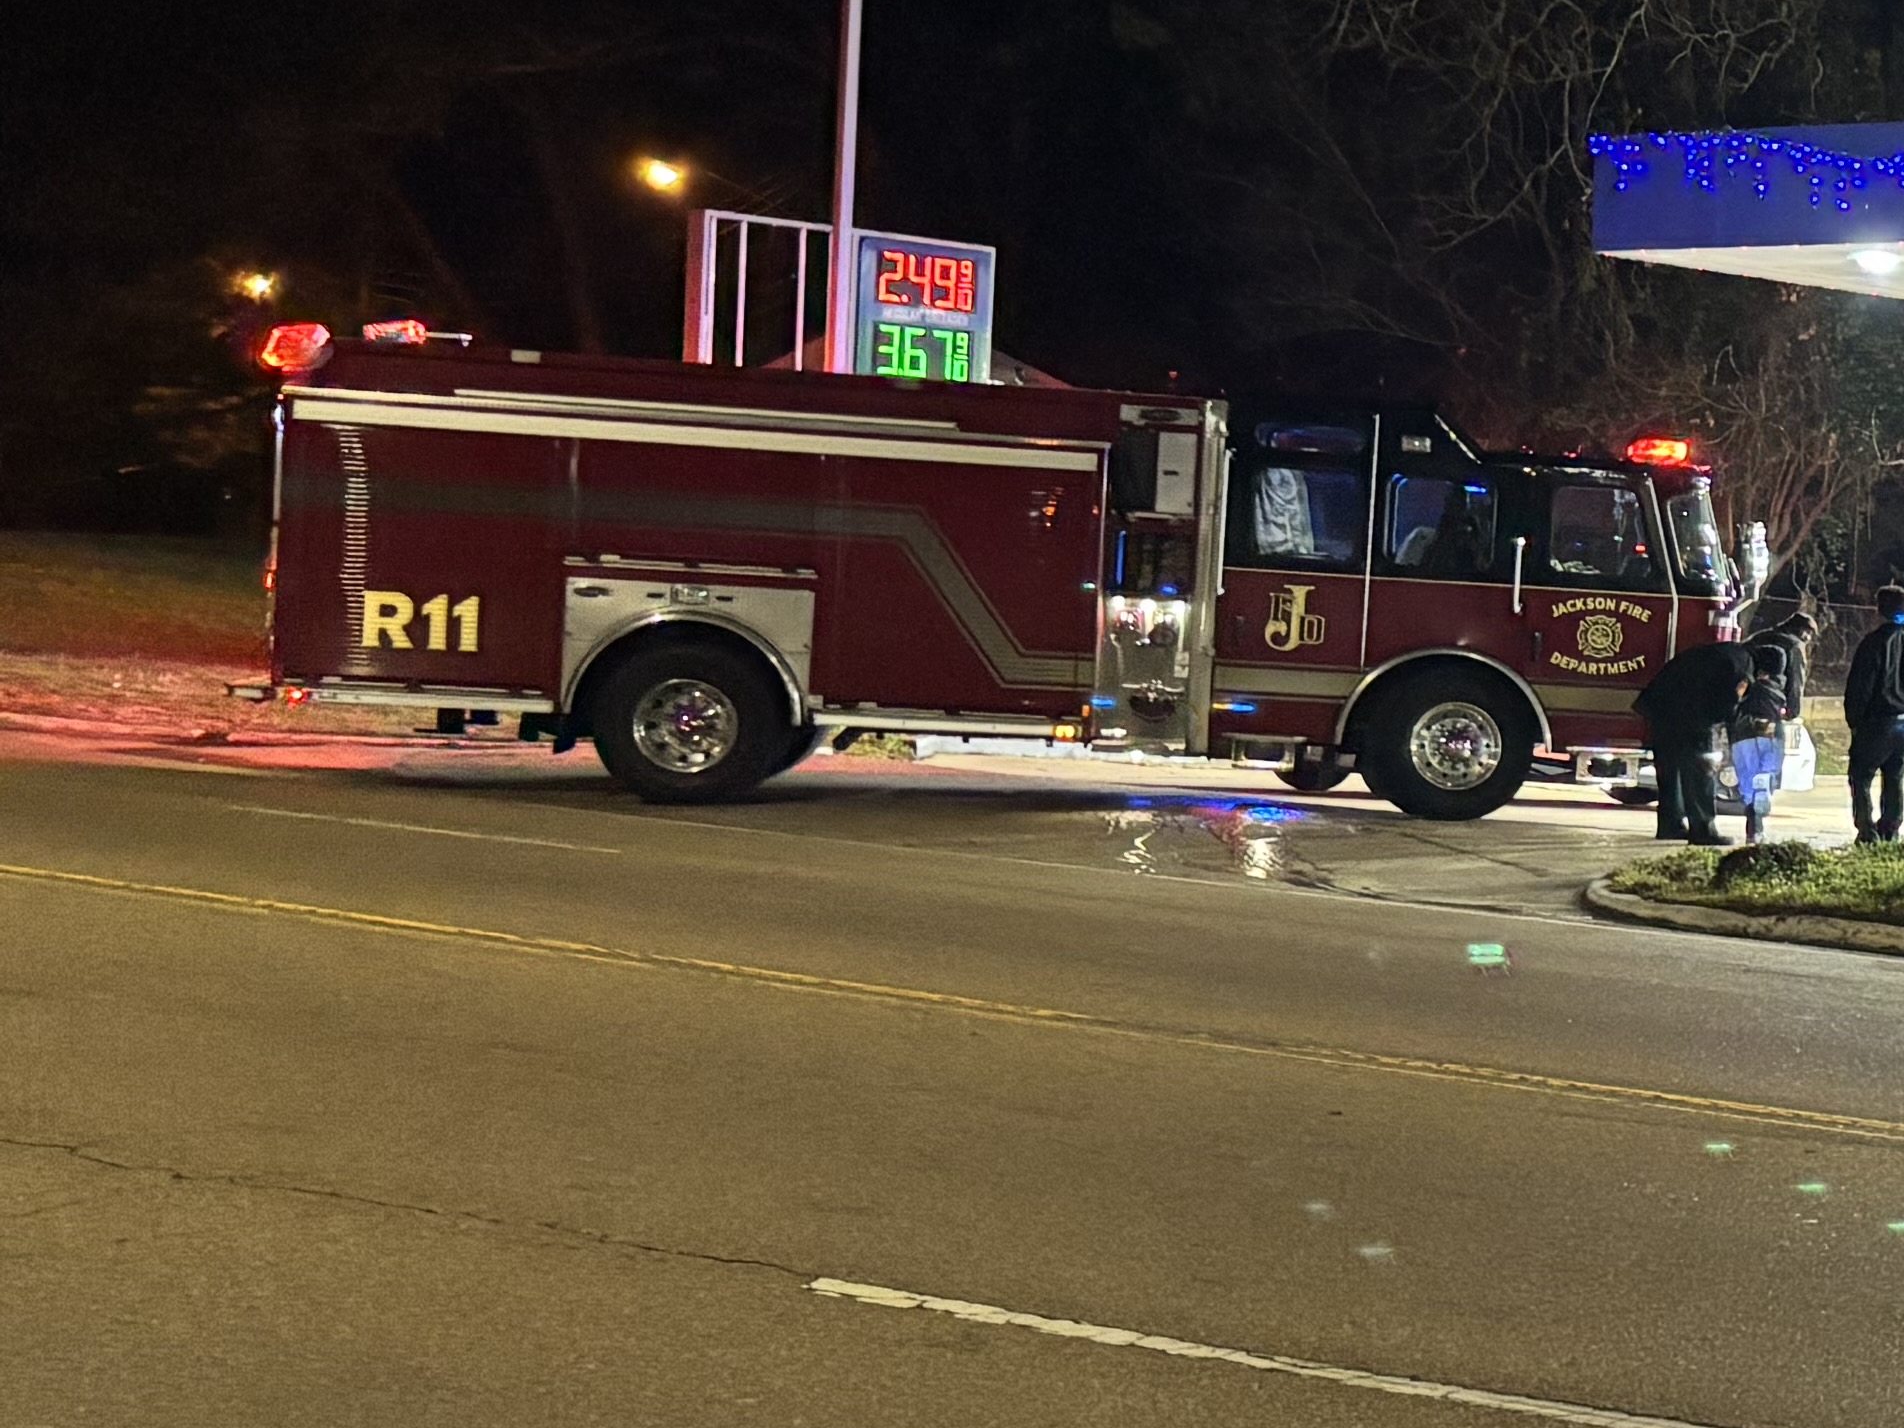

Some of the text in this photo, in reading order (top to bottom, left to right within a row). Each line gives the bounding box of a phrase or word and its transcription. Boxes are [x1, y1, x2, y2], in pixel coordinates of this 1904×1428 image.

[360, 589, 480, 652] R11
[1551, 596, 1653, 624] JACKSON FIRE
[1550, 651, 1646, 676] DEPARTMENT
